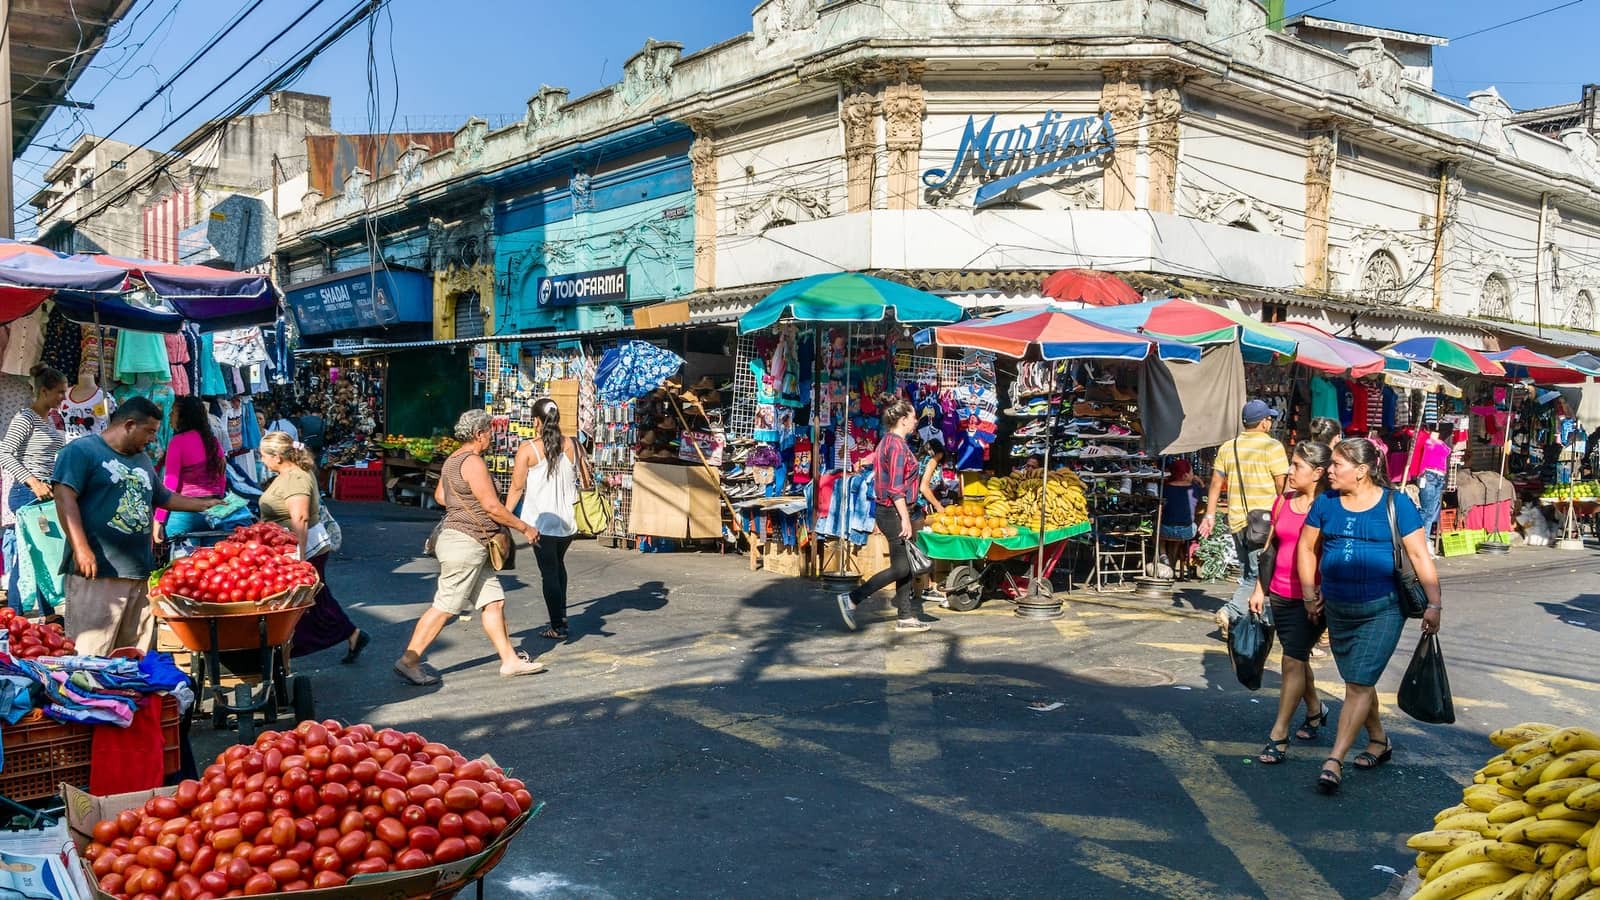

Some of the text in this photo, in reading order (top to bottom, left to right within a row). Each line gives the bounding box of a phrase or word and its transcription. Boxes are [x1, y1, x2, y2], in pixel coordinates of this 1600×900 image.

[922, 108, 1117, 190] Martin's
[319, 284, 351, 305] SHADAI
[554, 273, 624, 299] TODOFARMA
